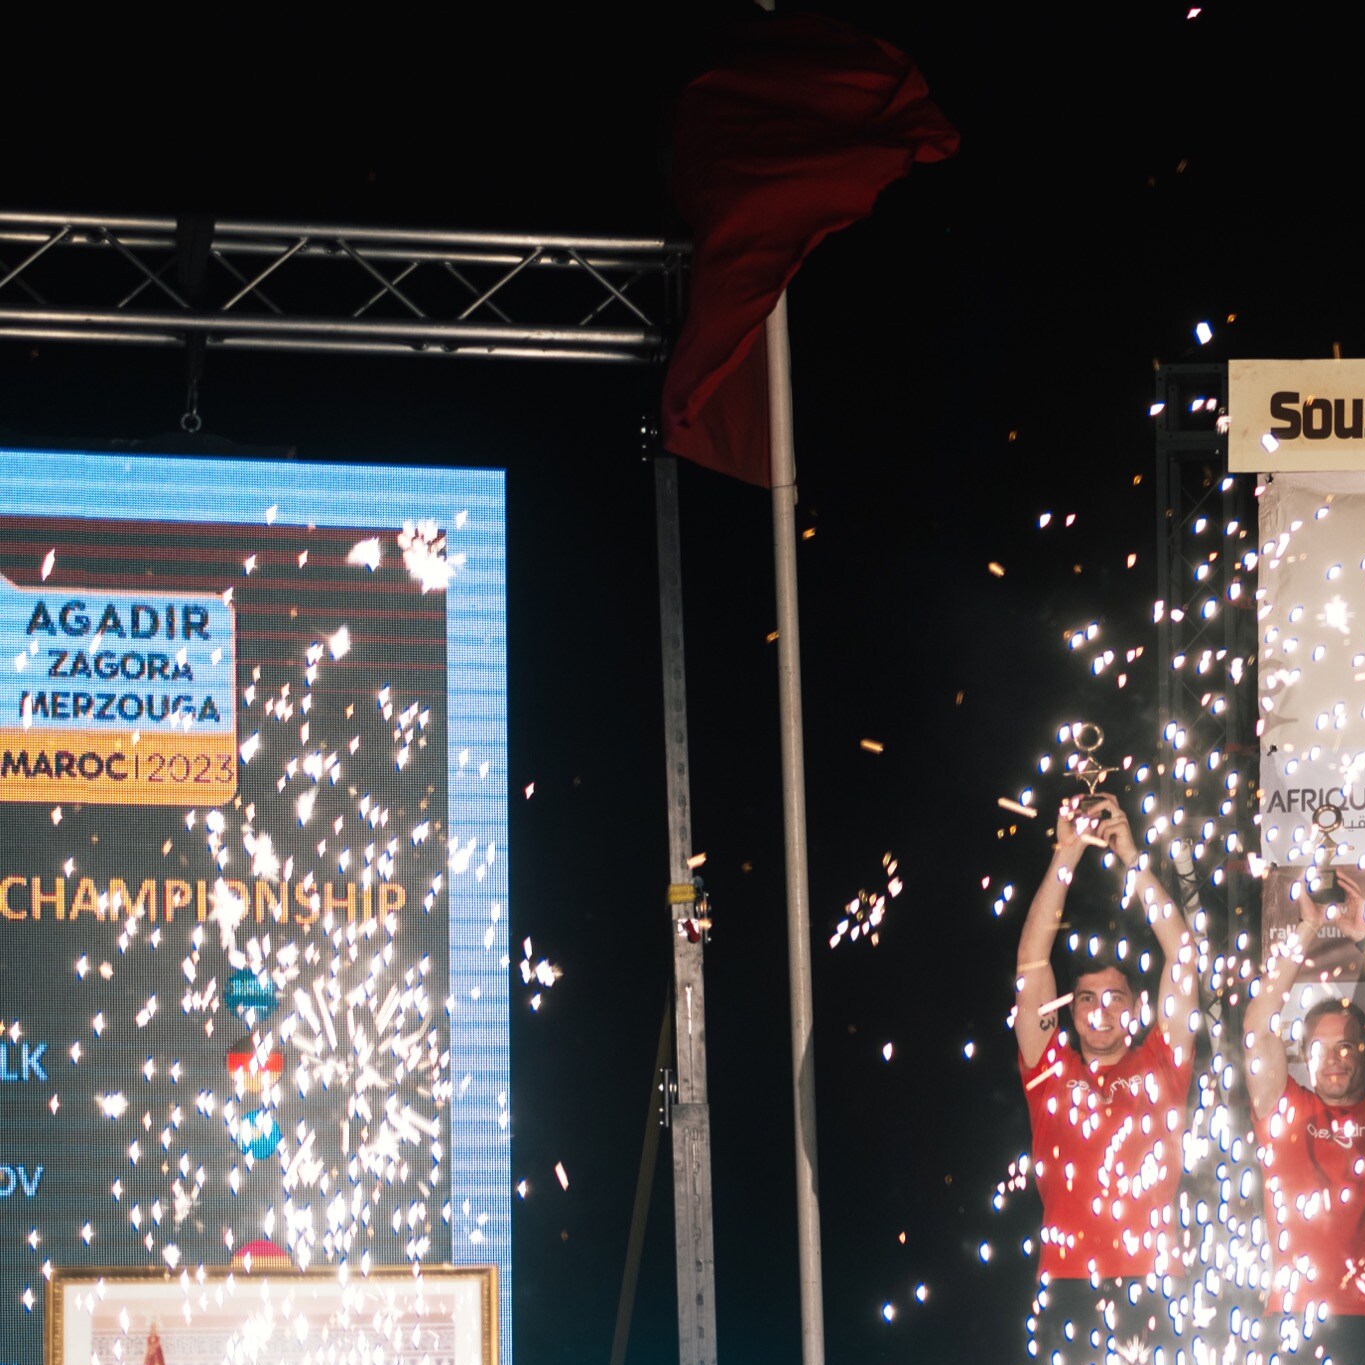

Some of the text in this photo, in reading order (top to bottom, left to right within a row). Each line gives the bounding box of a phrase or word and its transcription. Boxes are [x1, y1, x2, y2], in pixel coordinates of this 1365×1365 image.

[25, 600, 211, 641] AGADIR
[48, 649, 194, 682] ZAGORA
[19, 689, 221, 723] MERZOUGA
[0, 749, 235, 785] MAROC 2023
